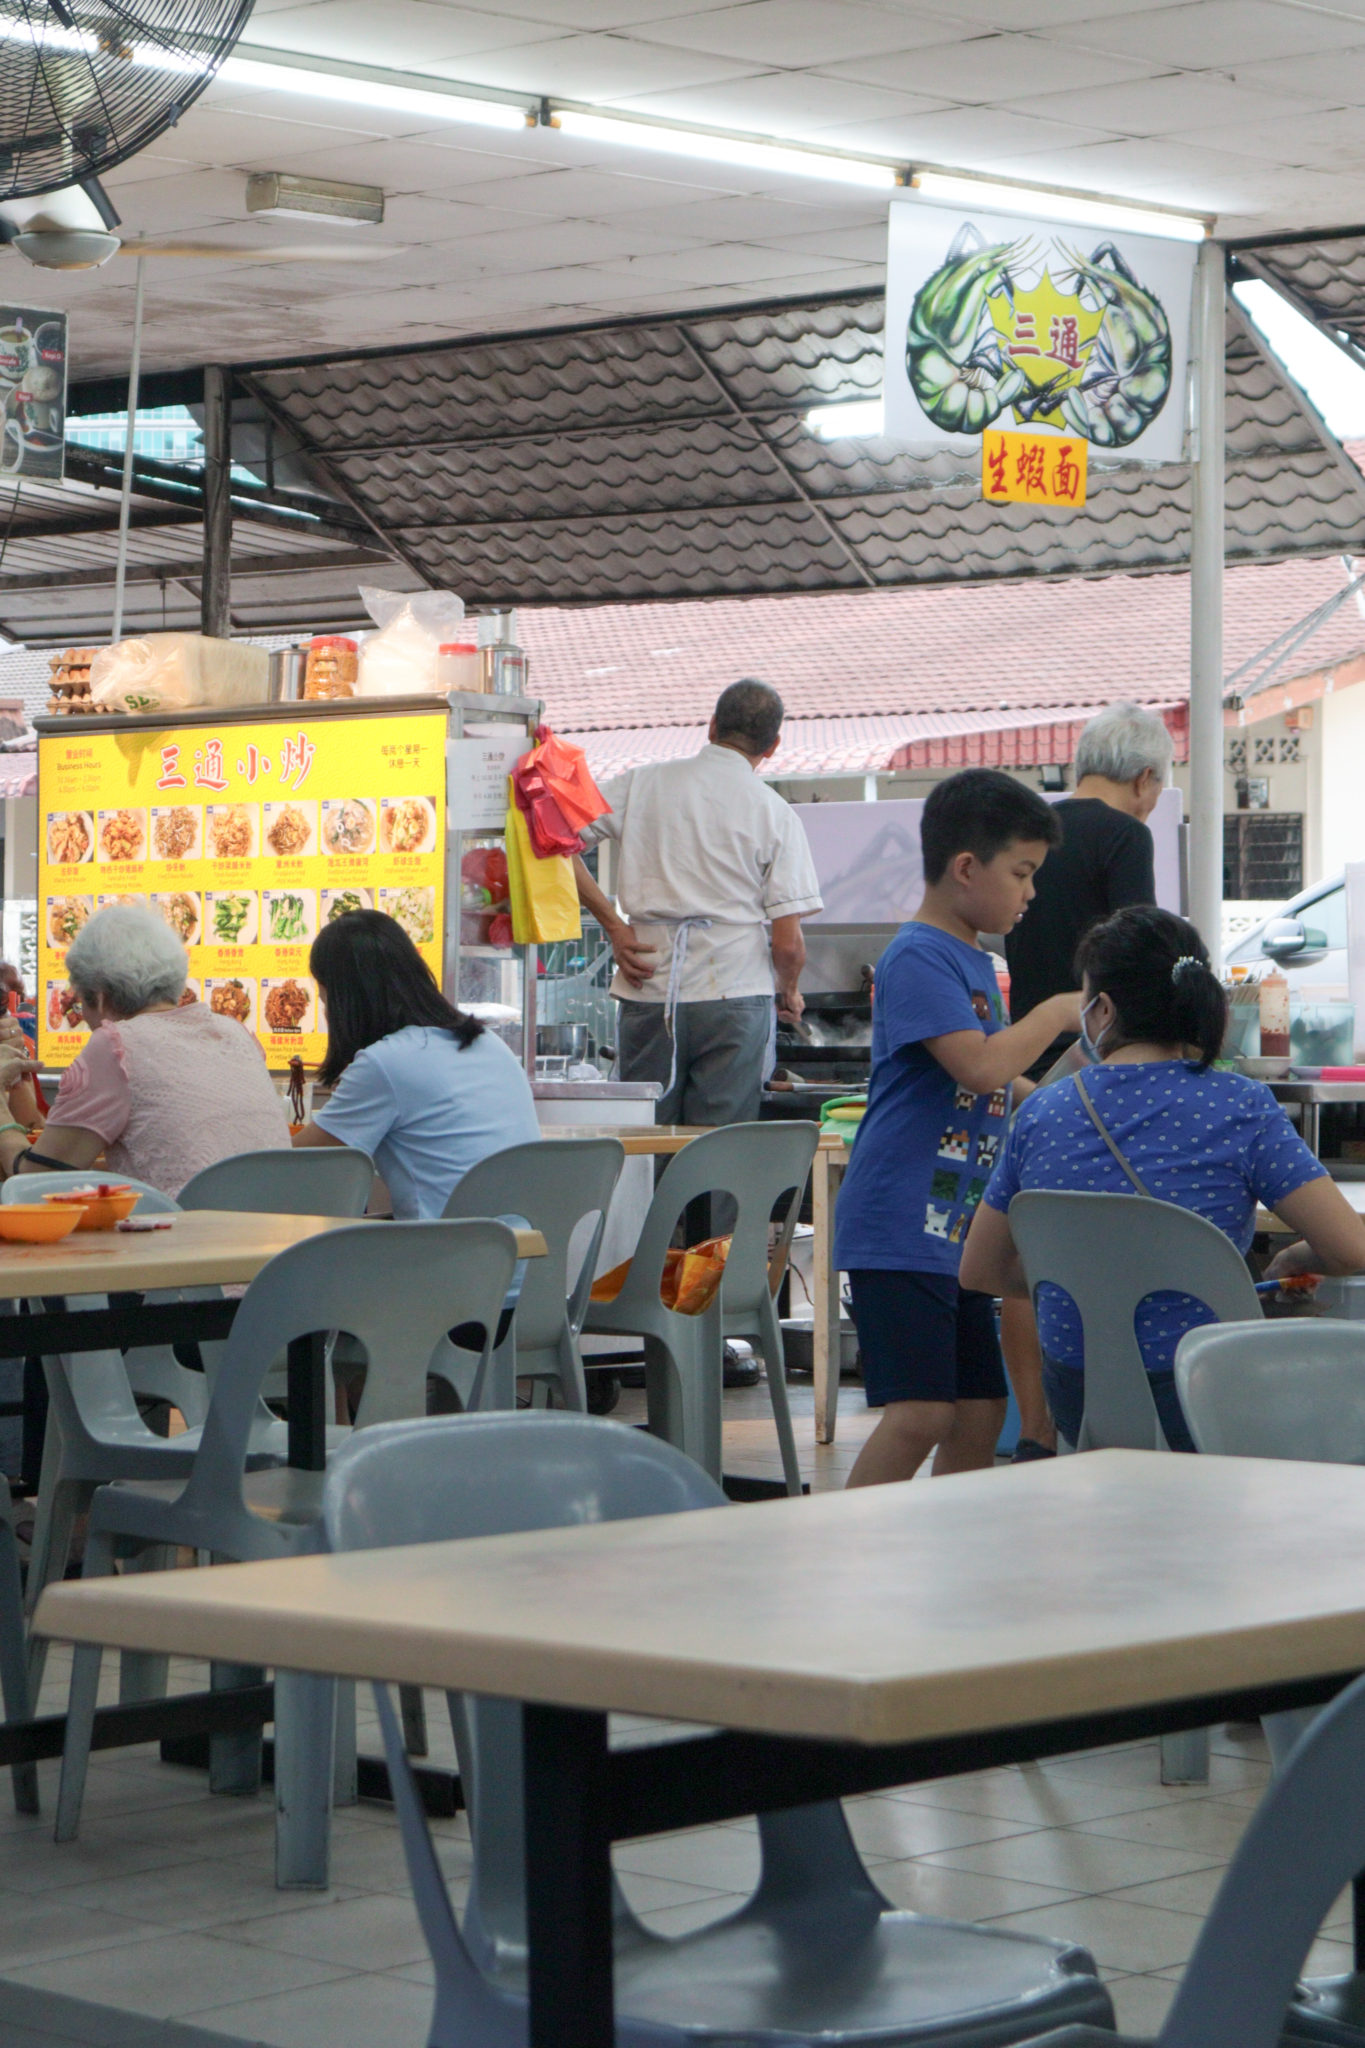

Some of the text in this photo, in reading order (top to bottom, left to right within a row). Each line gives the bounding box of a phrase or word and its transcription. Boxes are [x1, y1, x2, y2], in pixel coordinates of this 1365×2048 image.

[1007, 314, 1084, 370] 三通
[987, 436, 1081, 501] 生蝦面
[156, 731, 317, 792] 三通小炒
